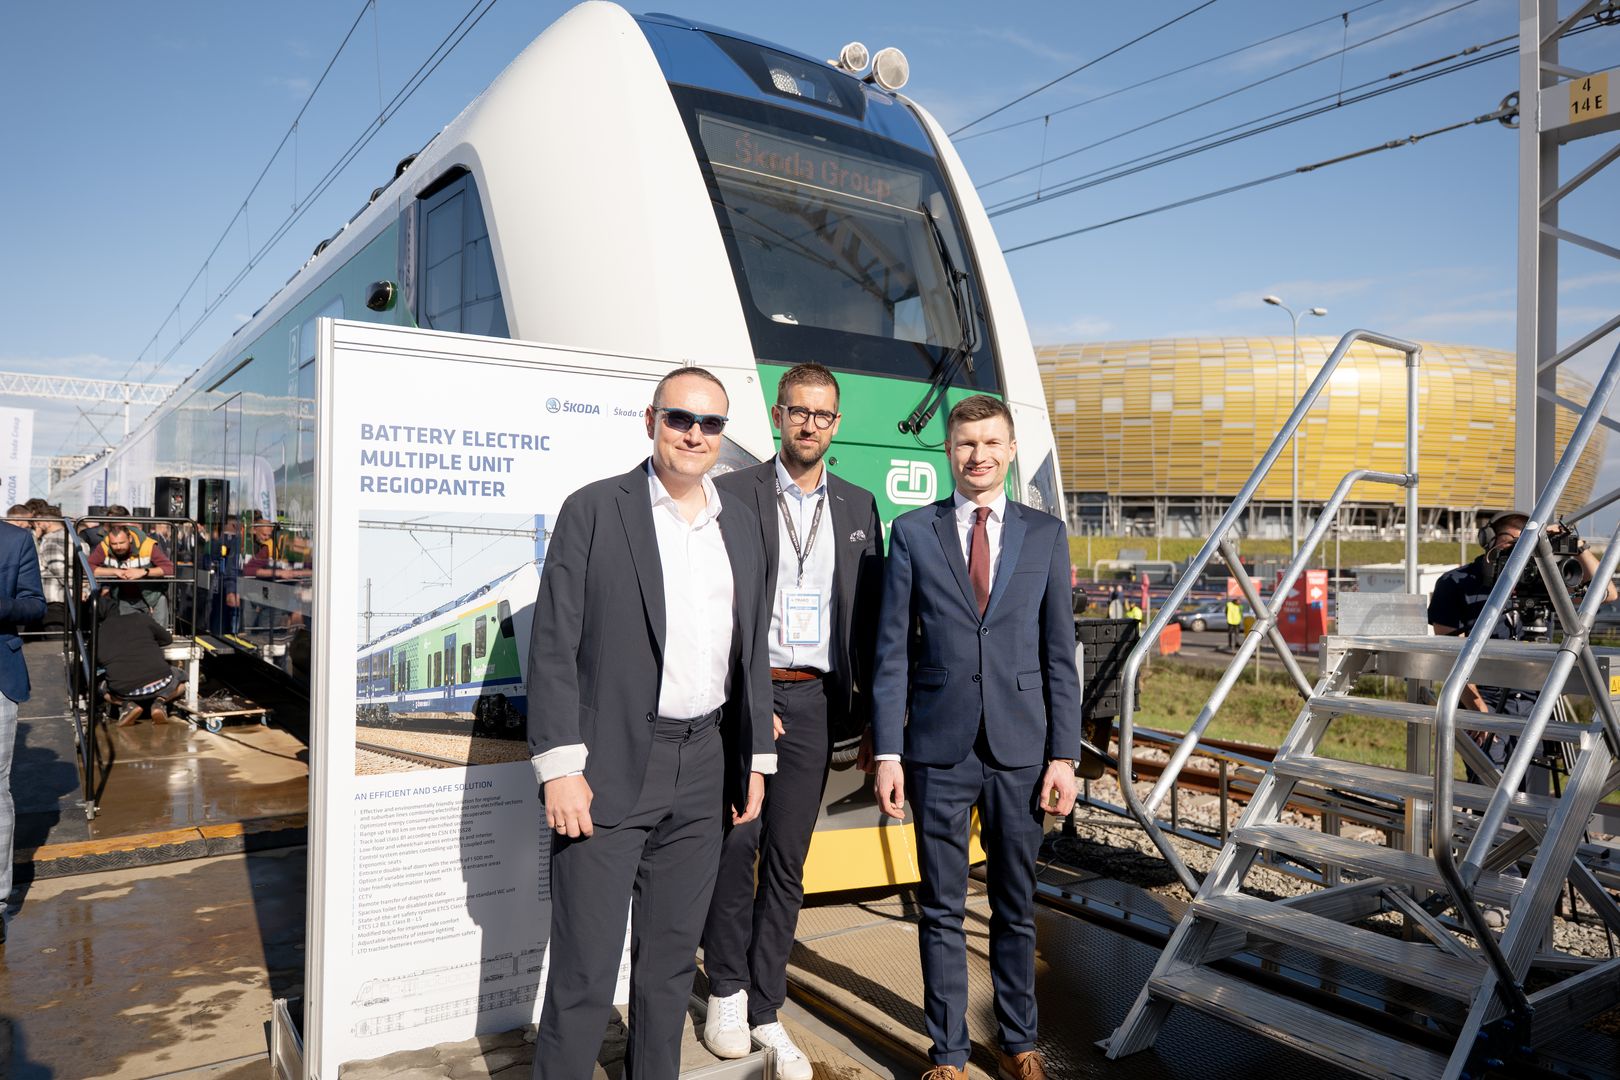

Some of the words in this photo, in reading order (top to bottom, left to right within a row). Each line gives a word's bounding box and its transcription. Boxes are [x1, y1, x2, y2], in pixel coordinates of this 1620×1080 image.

[1582, 77, 1591, 92] 4
[736, 131, 814, 180] Škoda
[822, 160, 891, 201] Group
[562, 400, 600, 414] ŠKODA
[614, 408, 637, 416] Škoda
[360, 423, 456, 444] BATTERY
[462, 430, 550, 451] ELECTRIC
[360, 450, 462, 471] MULTIPLE
[468, 456, 514, 474] UNIT
[360, 476, 506, 498] REGIOPANTER
[355, 792, 367, 801] AN
[370, 788, 411, 800] EFFICIENT
[413, 787, 430, 796] AND
[432, 785, 452, 794] SAFE
[455, 780, 492, 791] SOLUTION
[406, 816, 439, 825] consumption
[392, 879, 422, 888] information
[408, 893, 433, 902] diagnostic
[358, 908, 381, 917] Spacious
[428, 898, 455, 907] passengers
[358, 930, 381, 939] Modified
[405, 923, 429, 932] improved
[358, 938, 385, 948] Adjustable
[387, 934, 409, 943] intensity
[436, 926, 454, 935] lighting
[368, 944, 389, 953] traction
[390, 940, 412, 949] batteries
[414, 937, 434, 946] ensuring
[436, 932, 460, 941] maximum
[462, 929, 476, 938] safety
